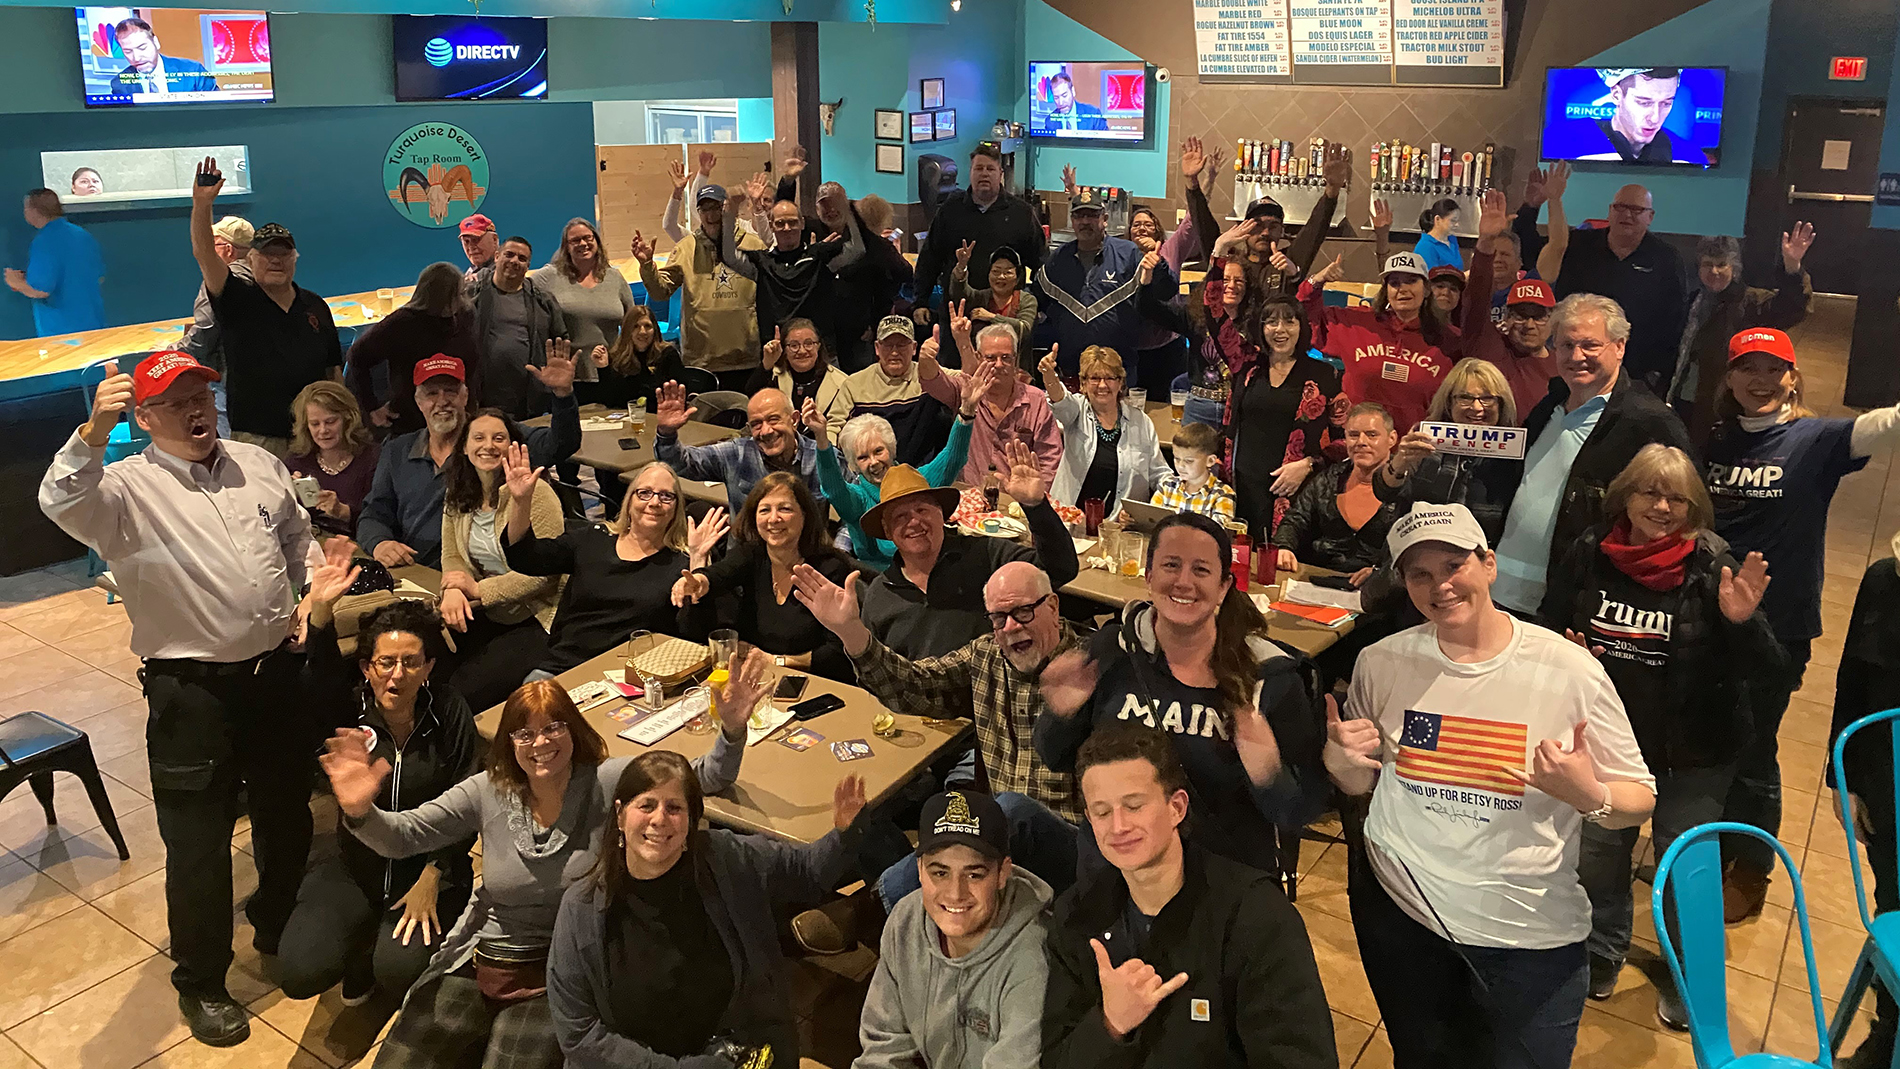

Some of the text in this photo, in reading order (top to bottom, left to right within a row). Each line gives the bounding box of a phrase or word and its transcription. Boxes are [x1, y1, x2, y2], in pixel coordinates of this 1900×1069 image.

[1219, 10, 1262, 18] MARBLE RED
[1292, 8, 1317, 17] BOSQUE
[1318, 8, 1354, 16] ELEPHANTS
[1366, 7, 1378, 15] TAP
[1413, 7, 1454, 16] MICHELOB
[1456, 7, 1481, 16] ULTRA
[1196, 21, 1217, 29] ROGUE
[1218, 21, 1248, 29] HAZELNUT
[1250, 20, 1274, 28] BROWN
[1320, 19, 1362, 28] BLUE MOON
[1396, 20, 1407, 28] RED
[1409, 20, 1426, 28] DOOR
[1428, 20, 1438, 28] ALE
[1440, 20, 1465, 28] VANILLA
[1466, 19, 1488, 28] CREME
[1247, 32, 1265, 40] 1554
[1326, 31, 1347, 40] EQUIS
[1350, 31, 1373, 39] LAGER
[1396, 32, 1427, 40] TRACTOR
[1429, 32, 1442, 40] RED
[1444, 32, 1465, 40] APPLE
[456, 45, 520, 59] DIRECTV
[1340, 43, 1375, 51] ESPECIAL
[1401, 43, 1436, 52] TRACTOR
[1438, 43, 1457, 52] MILK
[1459, 43, 1485, 52] STOUT
[1208, 54, 1232, 62] CUMBRE
[1234, 54, 1250, 62] SLICE
[1251, 54, 1258, 62] OF
[1426, 56, 1468, 64] BUD LIGHT
[1836, 59, 1864, 77] EXIT
[389, 126, 481, 164] Turquoise Desert
[410, 154, 461, 165] Tap Room
[1392, 256, 1415, 268] USA
[1517, 285, 1544, 298] USA
[1355, 344, 1440, 378] AMERICA
[1430, 426, 1516, 442] TRUMP
[1437, 439, 1507, 450] PENCE
[1707, 461, 1783, 487] RUMP
[1745, 489, 1783, 498] GREAT!
[1396, 511, 1454, 533] MAKE AMERICA
[1400, 522, 1422, 538] GREAT
[1599, 590, 1674, 641] rum
[1614, 640, 1638, 652] 2020
[1425, 787, 1437, 798] UP
[1440, 789, 1458, 802] FOR
[1461, 792, 1491, 807] BETSY
[1494, 798, 1522, 811] ROSS!
